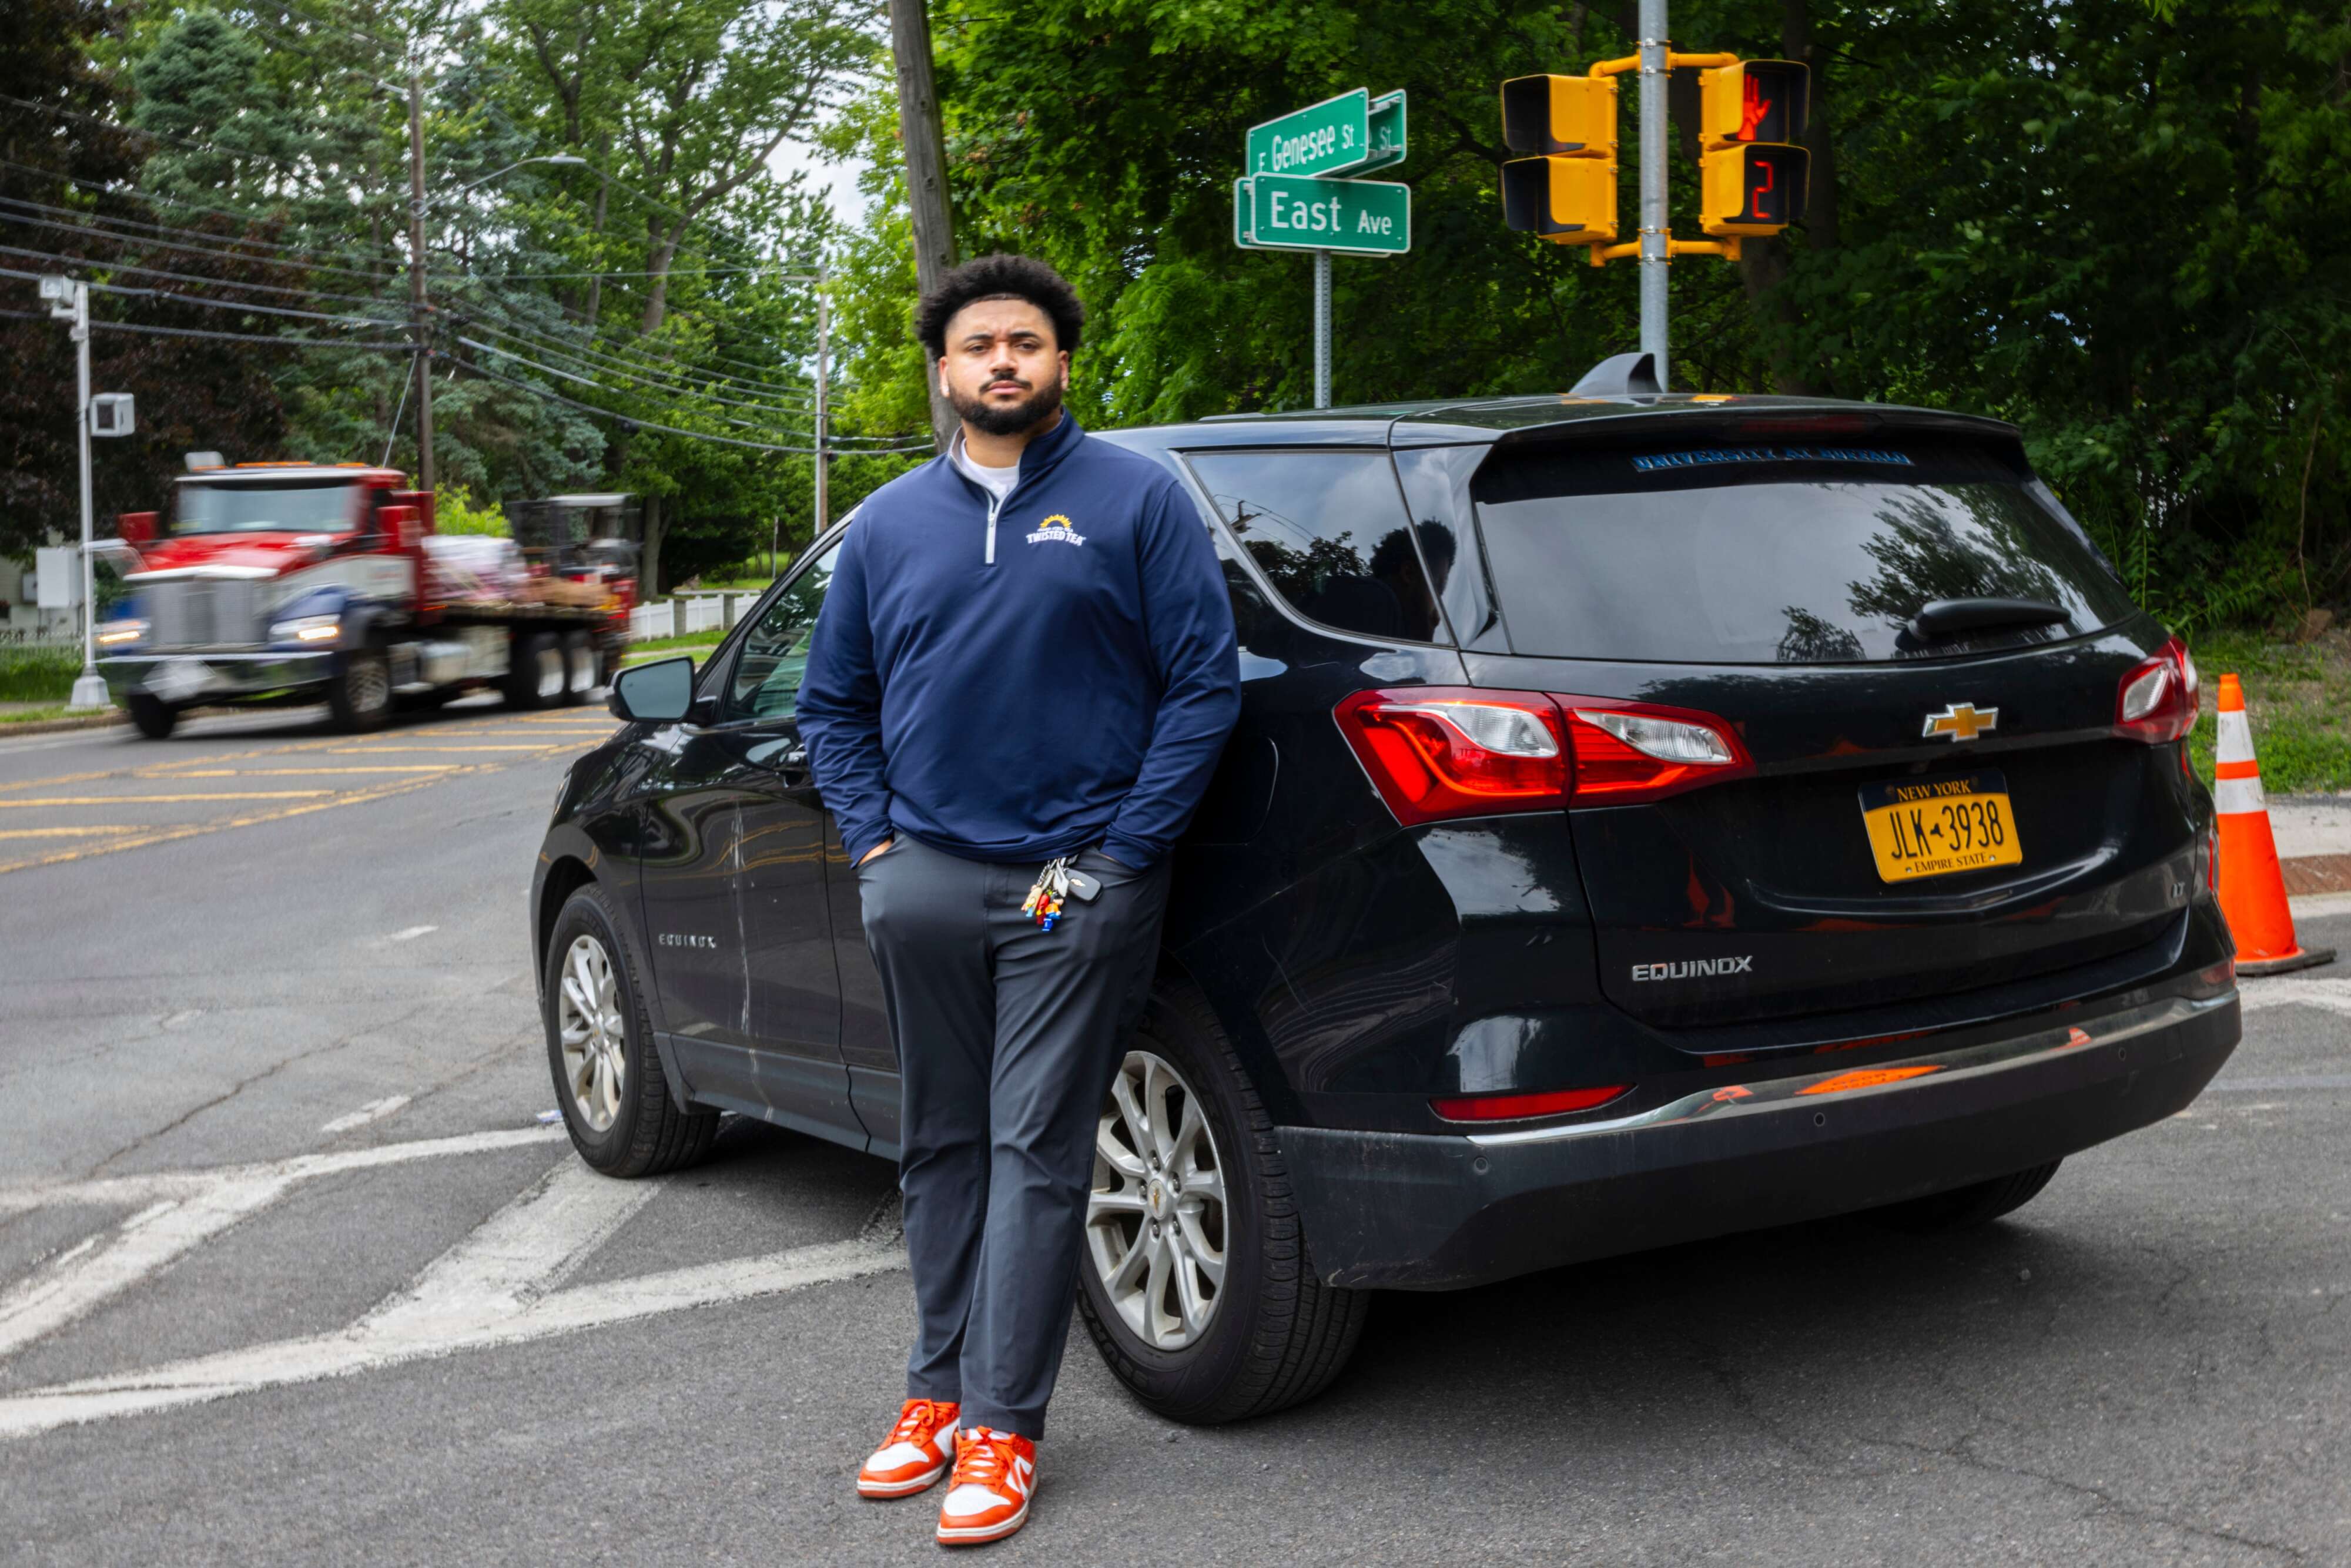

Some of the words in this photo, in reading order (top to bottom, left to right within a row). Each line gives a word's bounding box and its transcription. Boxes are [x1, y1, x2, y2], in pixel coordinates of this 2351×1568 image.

[1271, 125, 1336, 172] Genesee
[1341, 123, 1354, 149] St
[1752, 160, 1774, 218] 2
[1271, 190, 1342, 232] East
[1357, 209, 1392, 235] Ave
[1026, 530, 1066, 544] TWISTED
[1066, 532, 1083, 547] TEA
[1896, 784, 1931, 802] NEW
[1933, 779, 1972, 796] YORK
[1914, 858, 1955, 873] EMPIRE
[1956, 853, 1988, 867] STATE
[1632, 956, 1753, 981] EQUINOX
